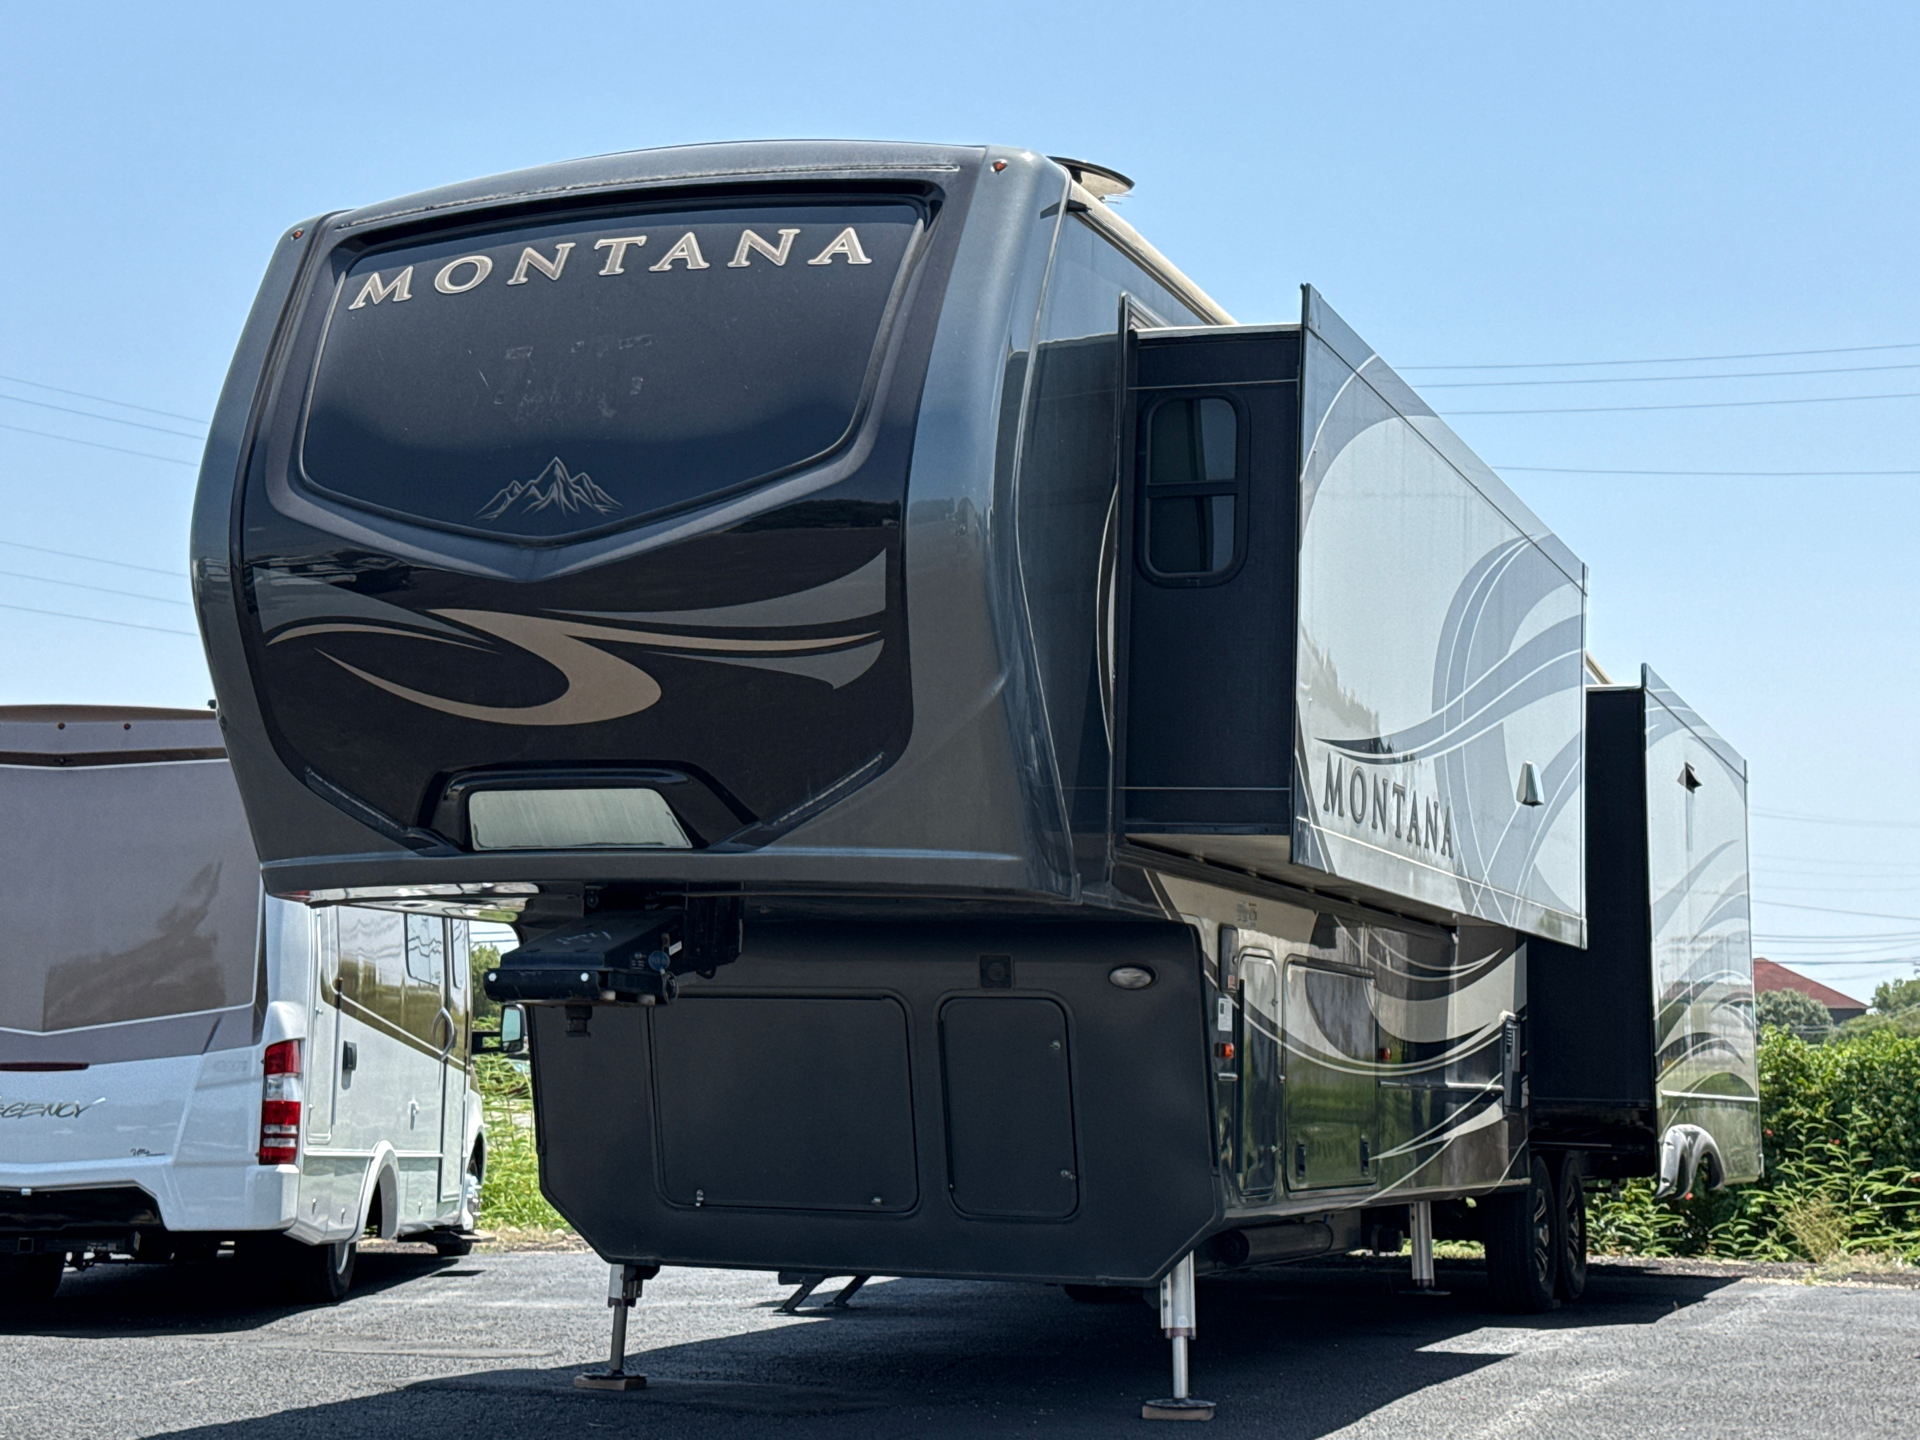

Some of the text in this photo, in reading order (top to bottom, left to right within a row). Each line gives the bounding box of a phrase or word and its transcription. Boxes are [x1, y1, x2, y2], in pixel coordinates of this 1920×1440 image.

[347, 226, 873, 311] MONTANA
[1322, 751, 1455, 860] MONTANA
[0, 1096, 107, 1119] GENCY
